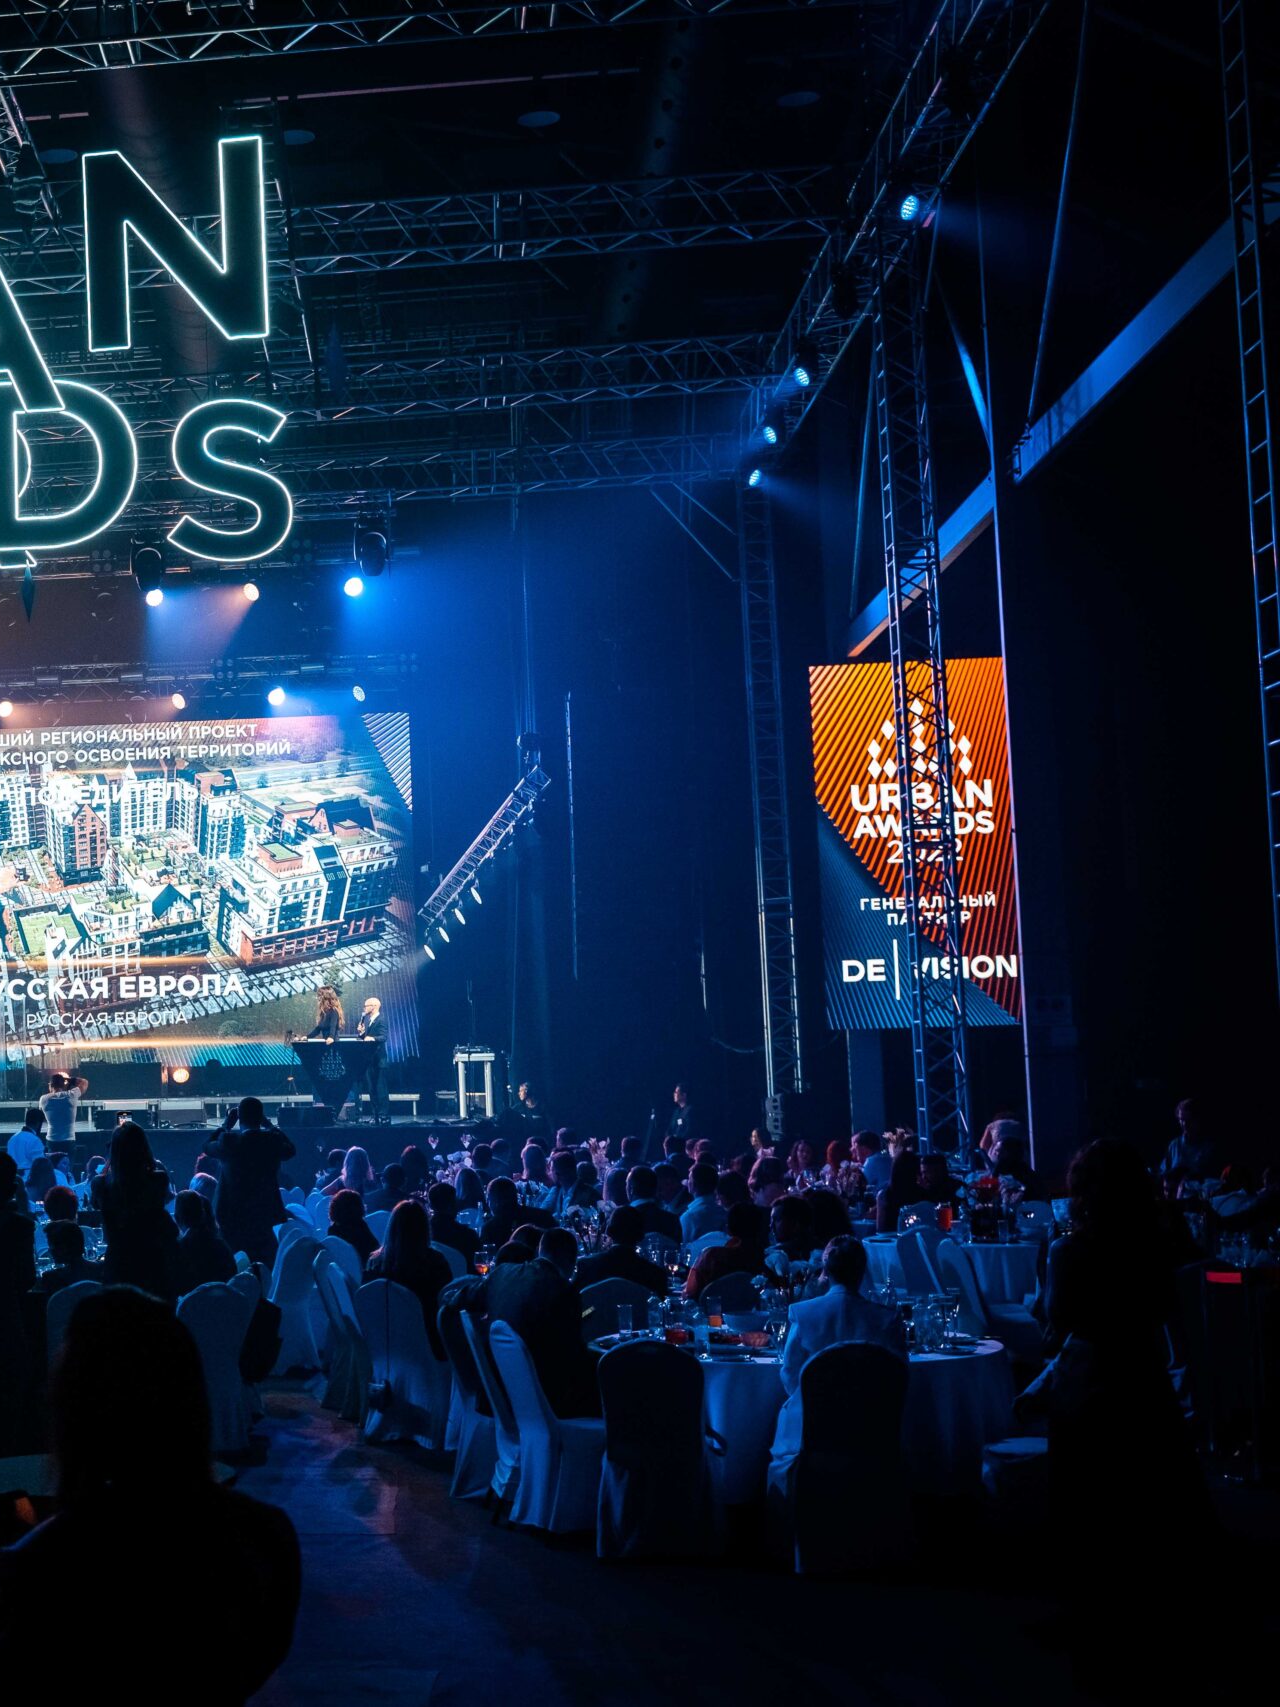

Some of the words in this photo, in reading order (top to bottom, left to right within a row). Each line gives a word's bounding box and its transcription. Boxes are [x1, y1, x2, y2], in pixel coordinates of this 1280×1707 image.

[40, 725, 182, 746] РЕГИОНАЛЬНЫЙ
[189, 723, 258, 740] ПРОЕКТ
[75, 746, 170, 764] ОСВОЕНИЯ
[179, 740, 291, 759] ТЕРРИТОРИЙ
[841, 958, 887, 983] DE
[120, 974, 246, 999] ЕВРОПА
[26, 1012, 109, 1028] РУССКАЯ
[114, 1010, 189, 1026] ЕВРОПА
